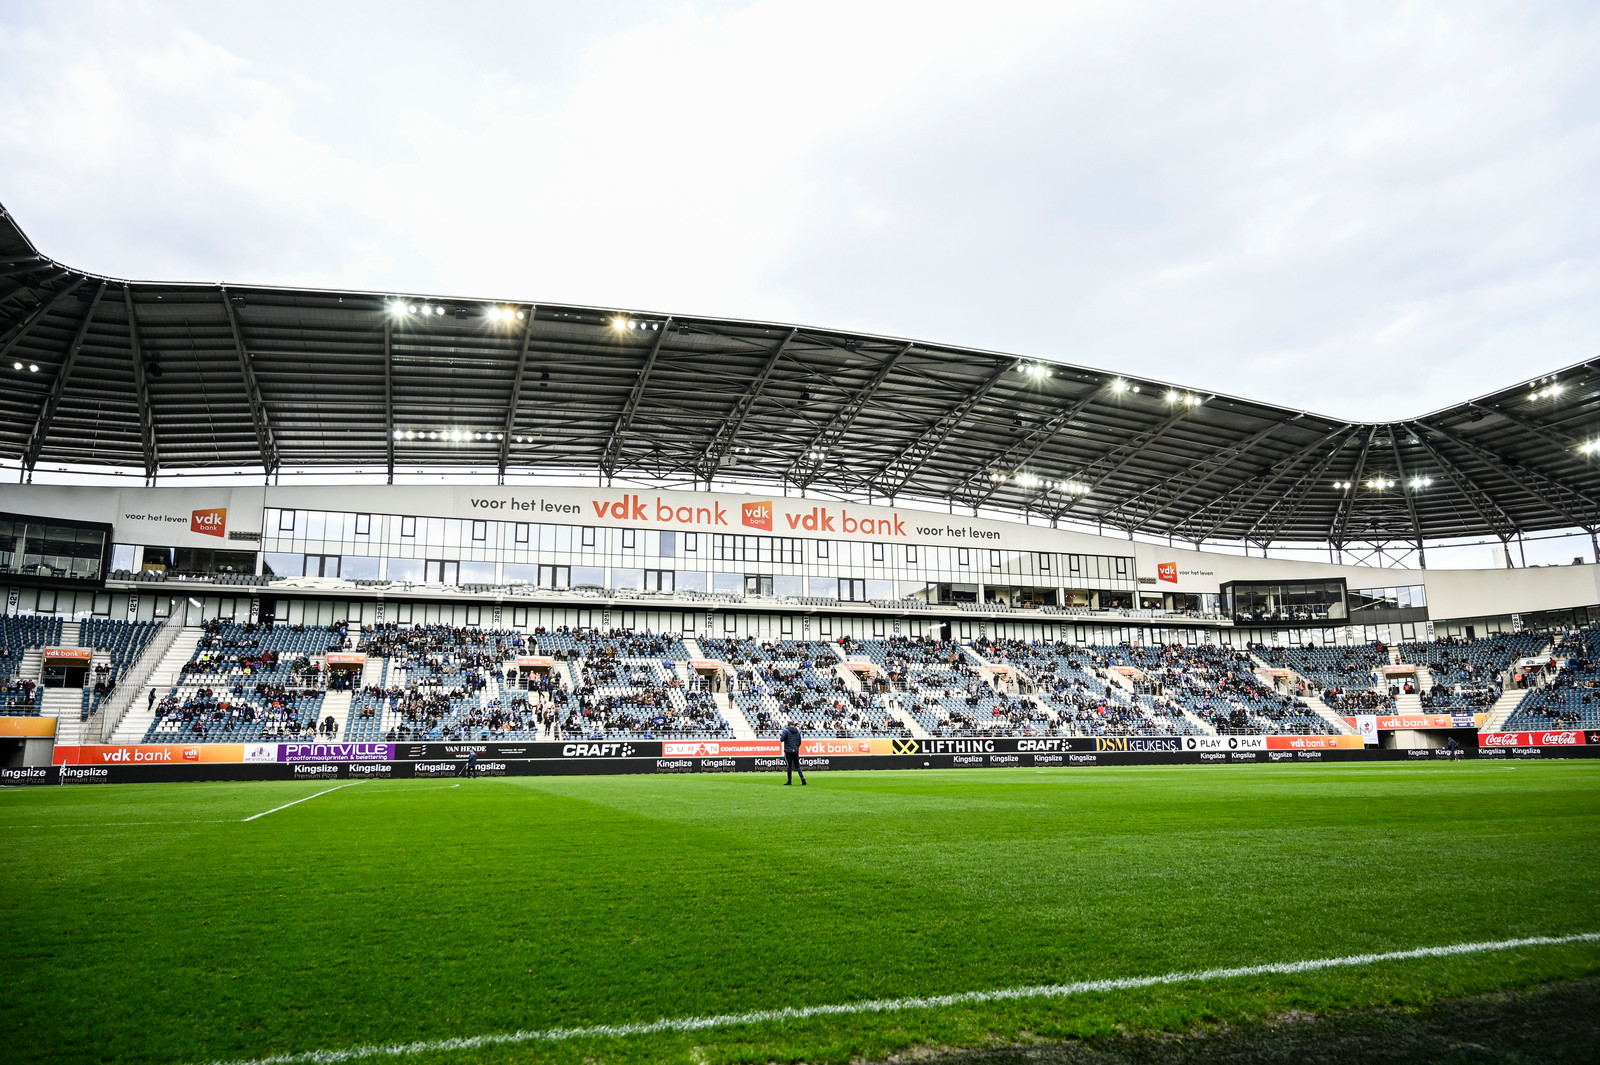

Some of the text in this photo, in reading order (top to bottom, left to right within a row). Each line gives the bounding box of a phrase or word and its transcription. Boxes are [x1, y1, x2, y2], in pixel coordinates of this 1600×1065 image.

[471, 497, 581, 514] voor het leven
[592, 494, 729, 525] vdk bank
[745, 506, 770, 518] vdk
[125, 513, 188, 524] voor het leven
[195, 513, 223, 526] vdk
[750, 517, 766, 525] bank
[785, 507, 907, 536] vdk bank
[916, 525, 1001, 540] voor het leven
[1159, 566, 1176, 575] vdk
[1382, 718, 1401, 728] vdk
[1403, 718, 1430, 727] bank
[1241, 739, 1262, 747] PLAY
[1290, 738, 1326, 748] vdk bank
[1485, 734, 1519, 746] Coca-Cola
[1542, 732, 1577, 745] Coca-Cola
[805, 742, 854, 753] vdk bank
[922, 741, 995, 753] LIFTHING
[1017, 740, 1061, 751] CRAFT
[1096, 738, 1128, 751] DSM
[1200, 739, 1222, 748] PLAY
[103, 748, 172, 762] vdk bank
[184, 749, 198, 757] vdk
[562, 744, 621, 757] CRAFT
[1408, 749, 1429, 757] Kingslize
[1478, 748, 1506, 756] Kingslize
[1512, 747, 1541, 755] Kingslize
[953, 755, 983, 764] Kingslize
[990, 755, 1019, 763] Kingslize
[1034, 754, 1063, 762] Kingslize
[1069, 754, 1097, 762] Kingslize
[1200, 752, 1226, 760] Kingslize
[466, 762, 506, 772] ngslize
[656, 760, 693, 769] Kingslize
[701, 759, 736, 768] Kingslize
[754, 758, 787, 767] Kingsliz
[294, 765, 338, 774] Kingslize
[349, 764, 392, 773] Kingslize
[415, 763, 456, 772] Kingslize
[59, 767, 108, 778] Kingslize
